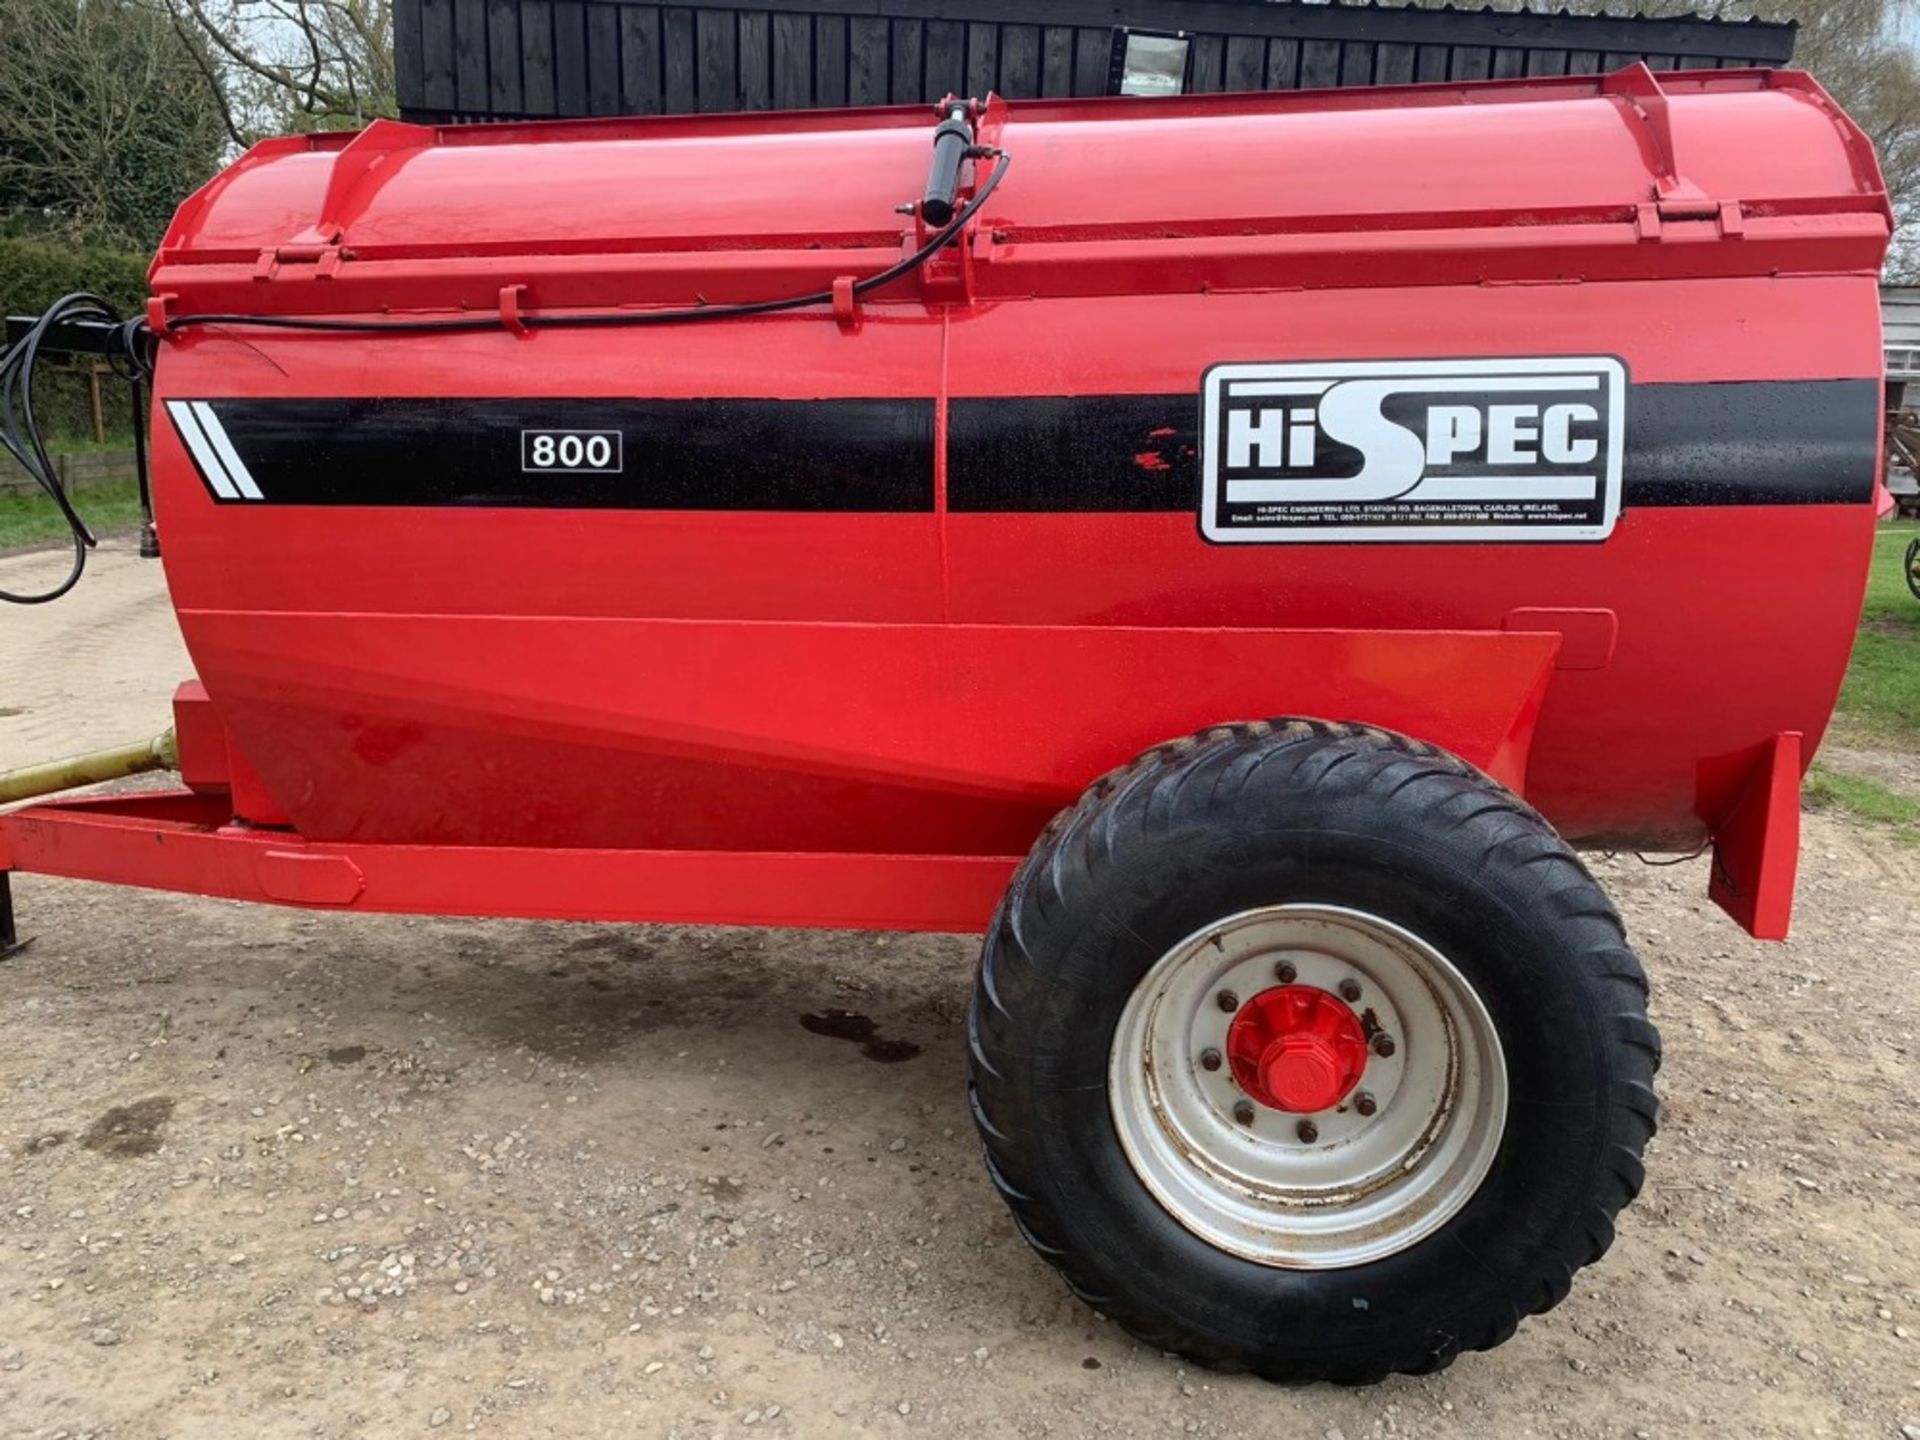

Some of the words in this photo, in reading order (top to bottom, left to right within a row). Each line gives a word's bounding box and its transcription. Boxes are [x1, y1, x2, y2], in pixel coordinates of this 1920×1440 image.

[532, 435, 612, 467] 800
[1289, 505, 1343, 513] ENGINEERING
[1363, 503, 1397, 513] STATION
